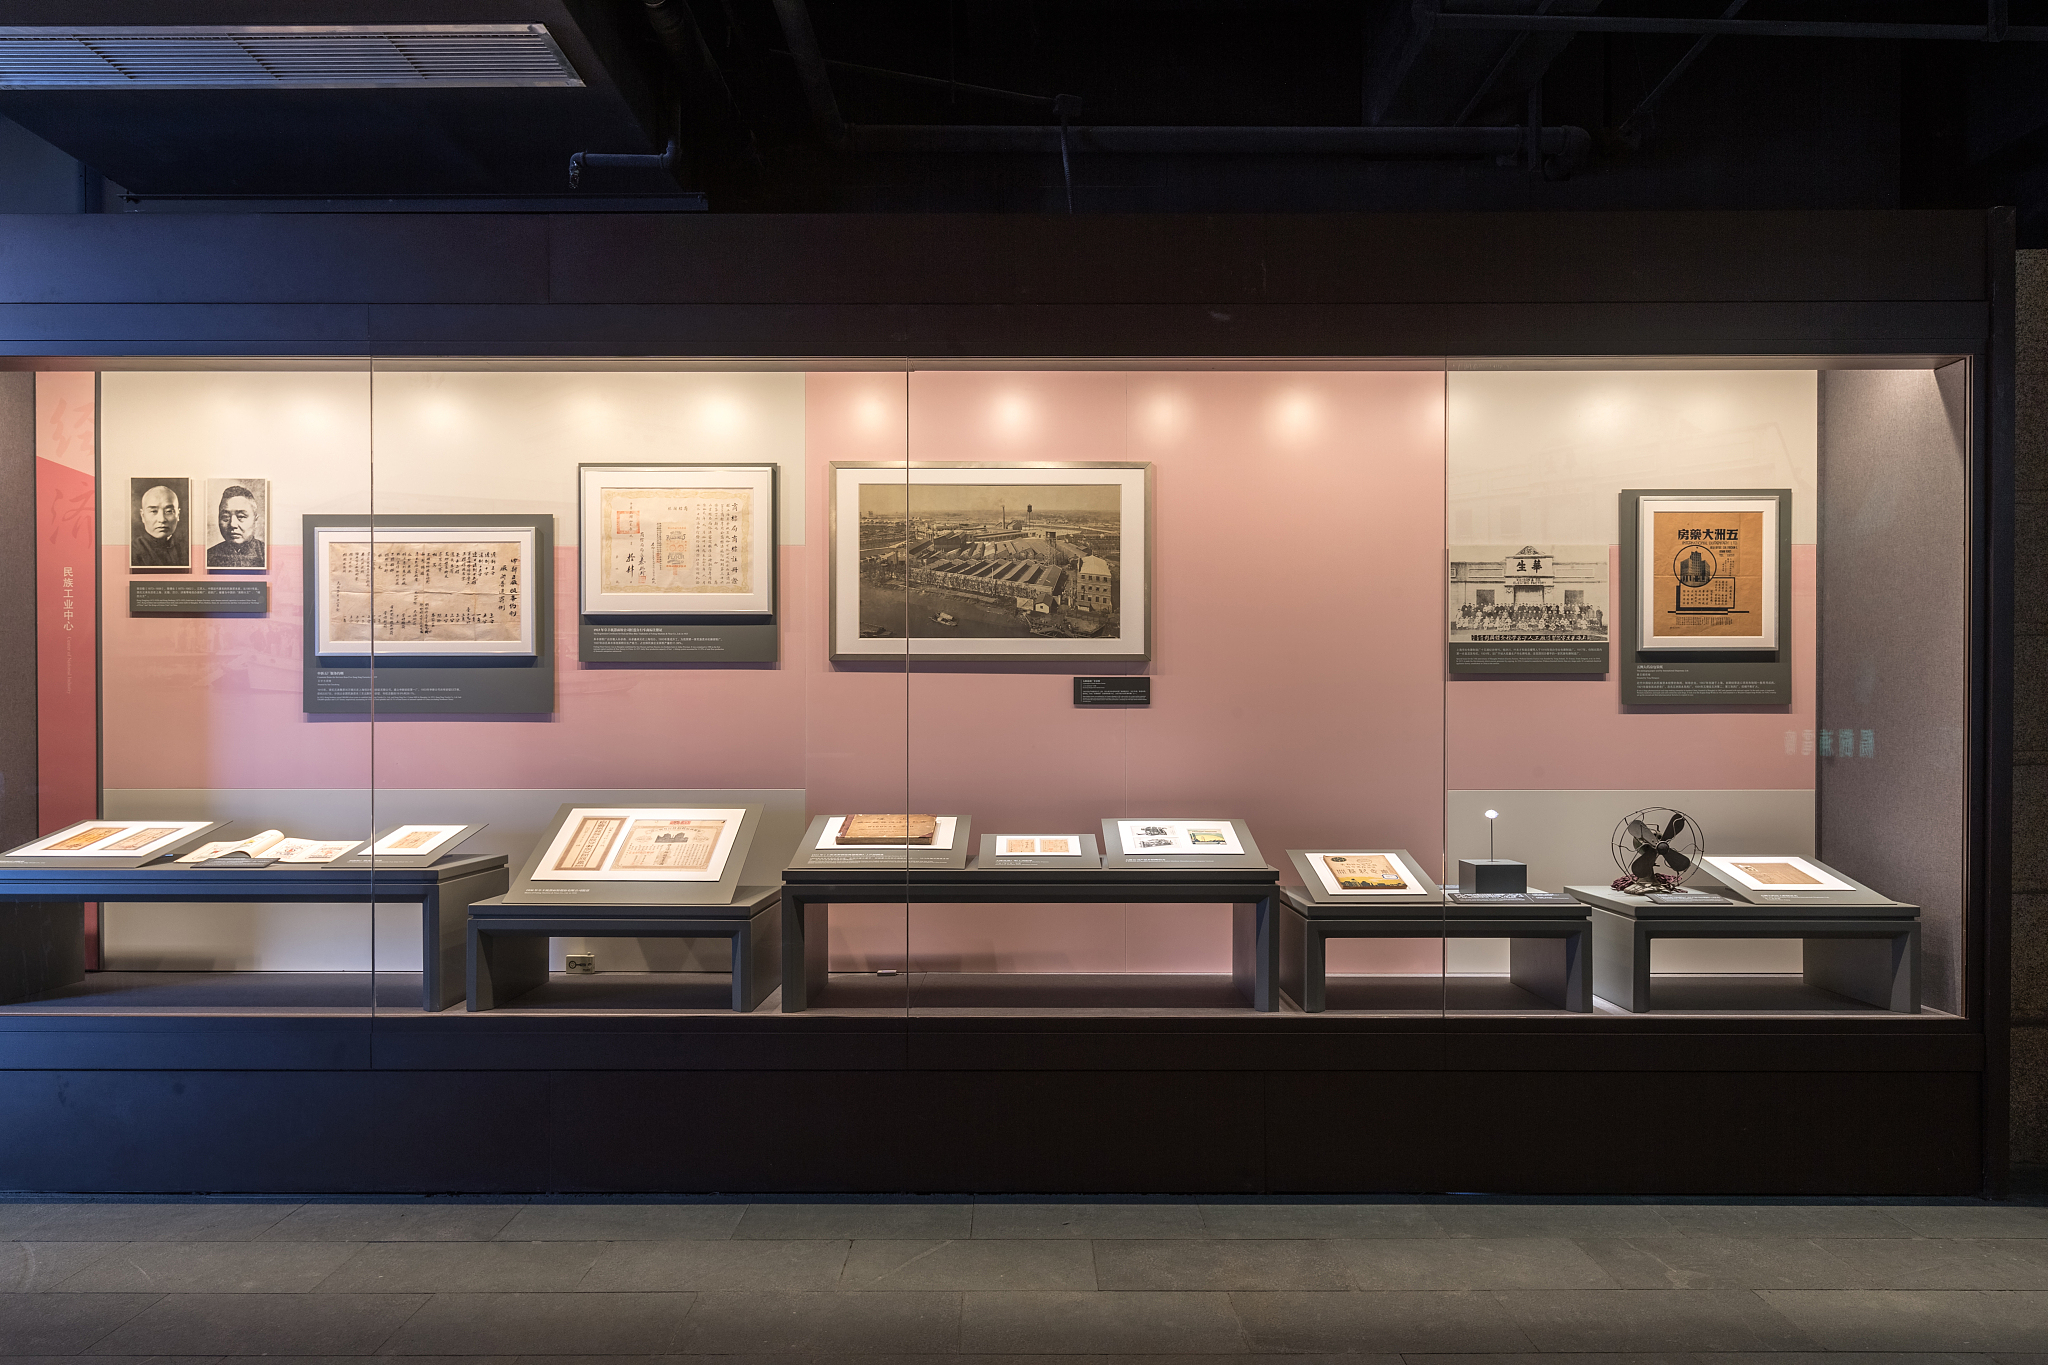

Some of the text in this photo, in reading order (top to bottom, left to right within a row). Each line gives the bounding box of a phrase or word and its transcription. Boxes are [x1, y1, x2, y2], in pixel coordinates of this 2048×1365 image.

[1517, 560, 1542, 573] 華生
[62, 566, 74, 631] 民族工业中心
